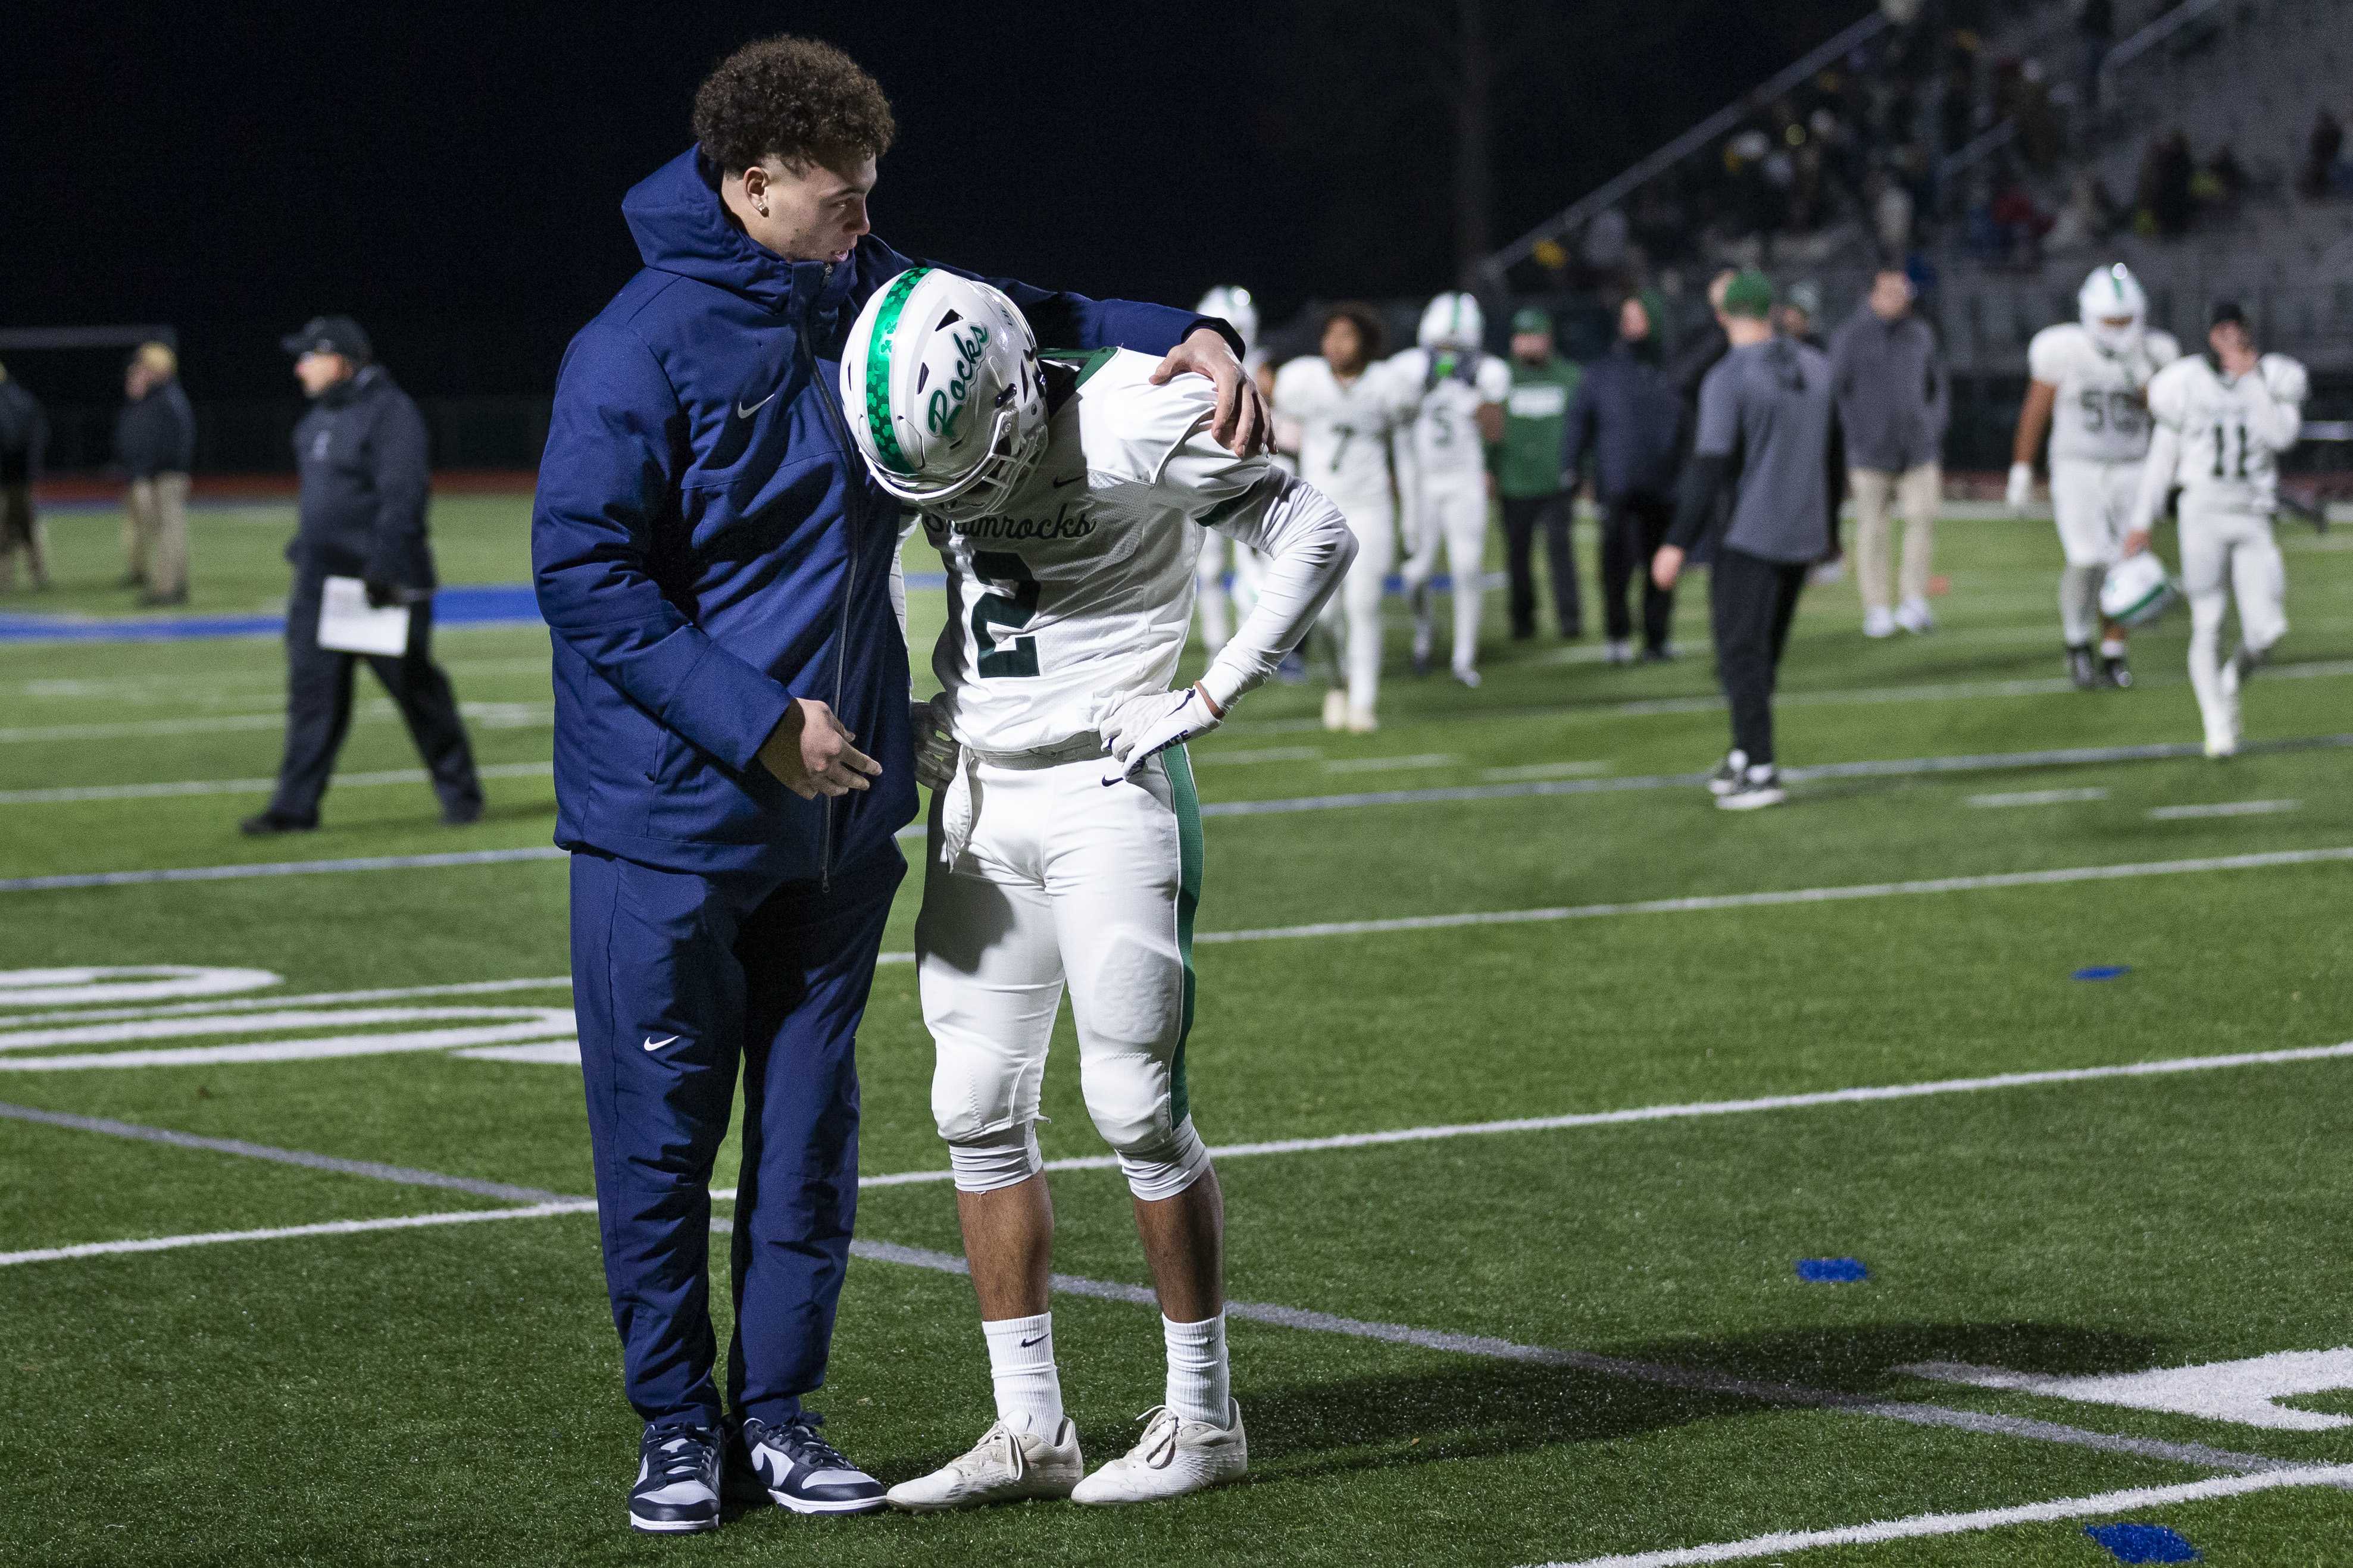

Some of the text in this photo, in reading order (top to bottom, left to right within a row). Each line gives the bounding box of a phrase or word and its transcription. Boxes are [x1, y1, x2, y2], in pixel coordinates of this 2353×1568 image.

[928, 326, 988, 442] Rocks
[1329, 423, 1355, 473] 7
[2211, 423, 2248, 478] 11
[970, 550, 1041, 679] 2
